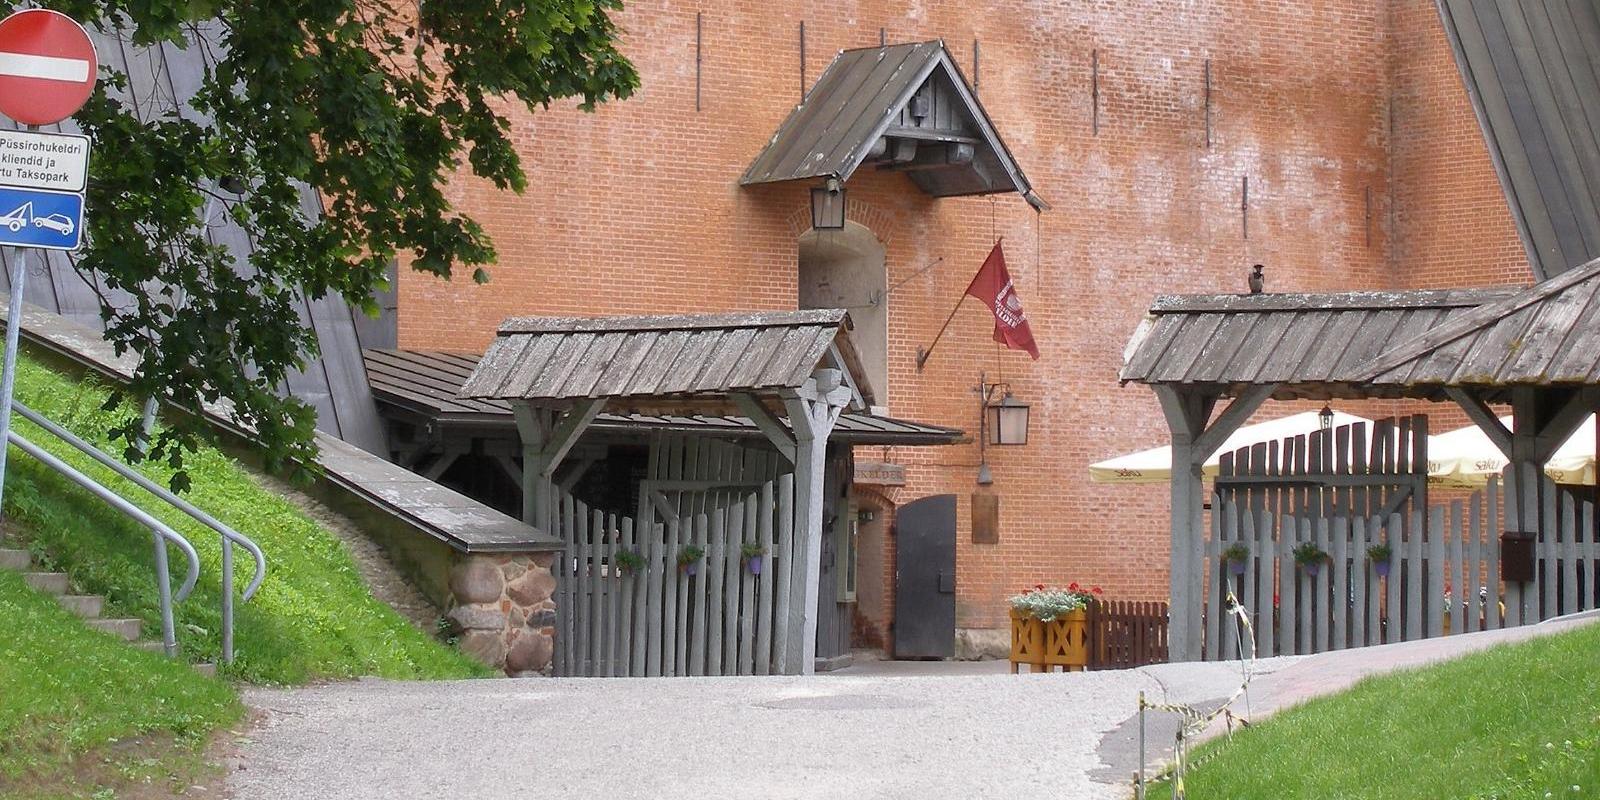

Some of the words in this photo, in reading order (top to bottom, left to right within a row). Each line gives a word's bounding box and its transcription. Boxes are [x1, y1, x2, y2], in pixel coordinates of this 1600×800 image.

[0, 138, 81, 154] Püssirohukeldri
[1, 153, 43, 166] kliendid
[45, 157, 56, 169] ja
[16, 168, 69, 183] Taksopark
[1474, 458, 1500, 471] saku
